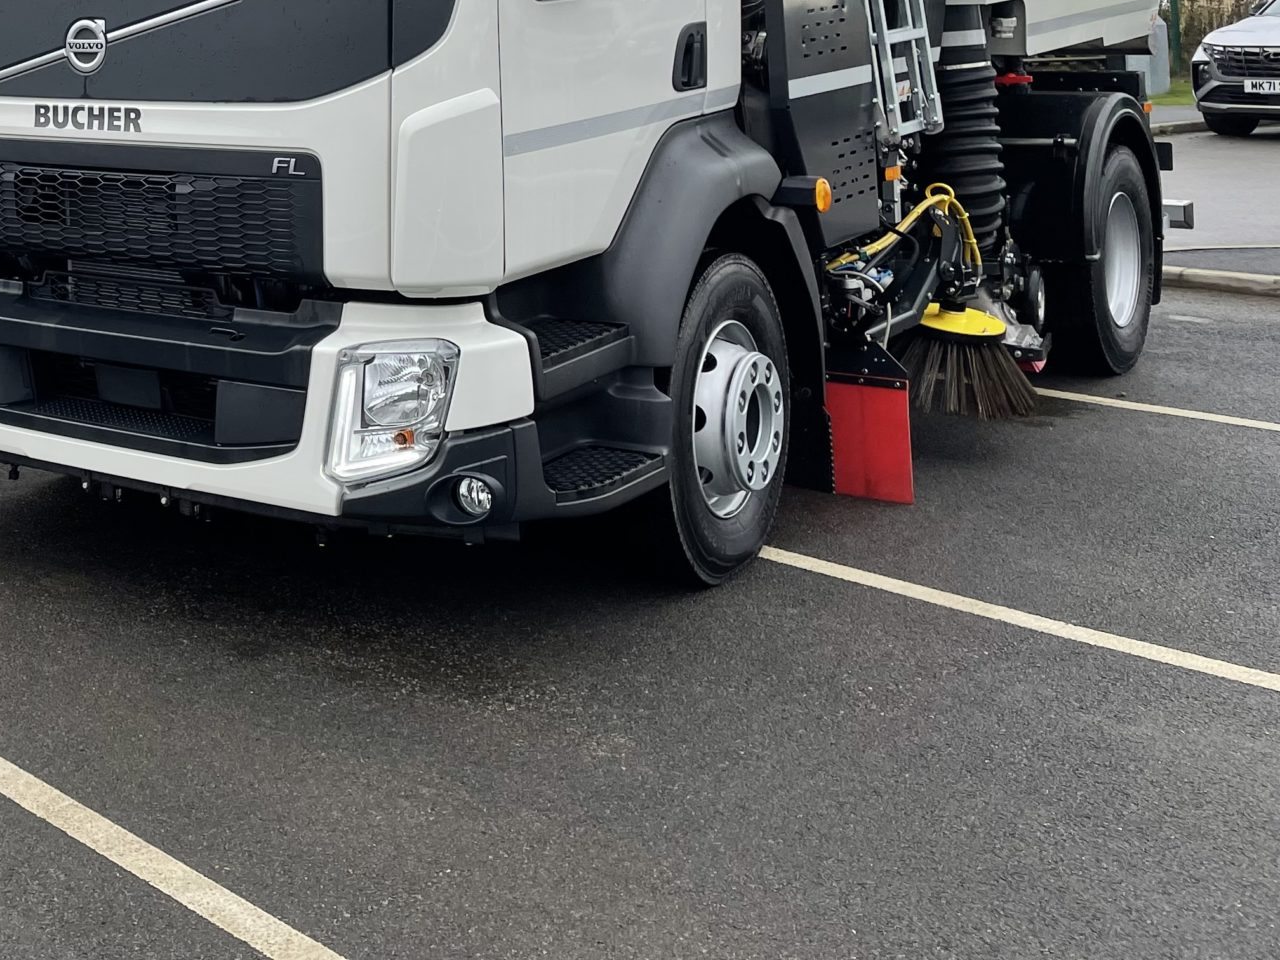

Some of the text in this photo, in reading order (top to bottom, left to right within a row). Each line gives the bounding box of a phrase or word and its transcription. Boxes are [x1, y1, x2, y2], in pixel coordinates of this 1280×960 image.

[68, 42, 104, 50] VOLVO
[1251, 81, 1276, 91] MK71
[34, 104, 142, 133] BUCHER
[271, 157, 306, 176] FL
